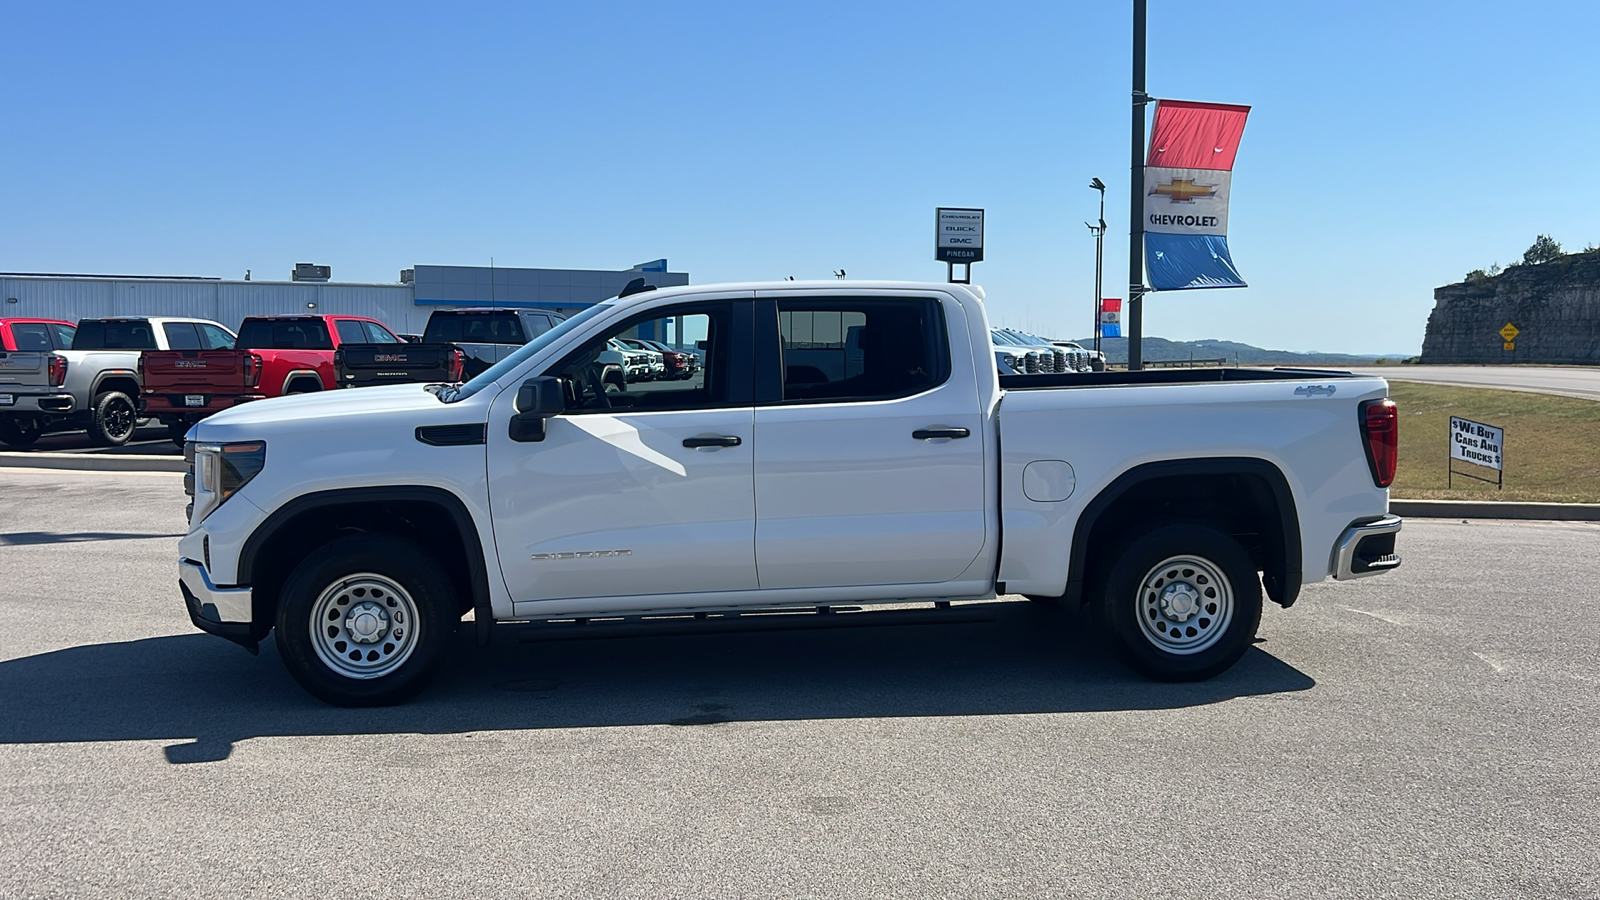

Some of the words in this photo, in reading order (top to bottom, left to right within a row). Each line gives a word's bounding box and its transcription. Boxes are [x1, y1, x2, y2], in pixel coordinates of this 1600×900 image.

[1150, 213, 1218, 227] CHEVROLET
[374, 354, 407, 362] GMC
[174, 360, 207, 368] GMC
[531, 549, 633, 561] SIERRA
